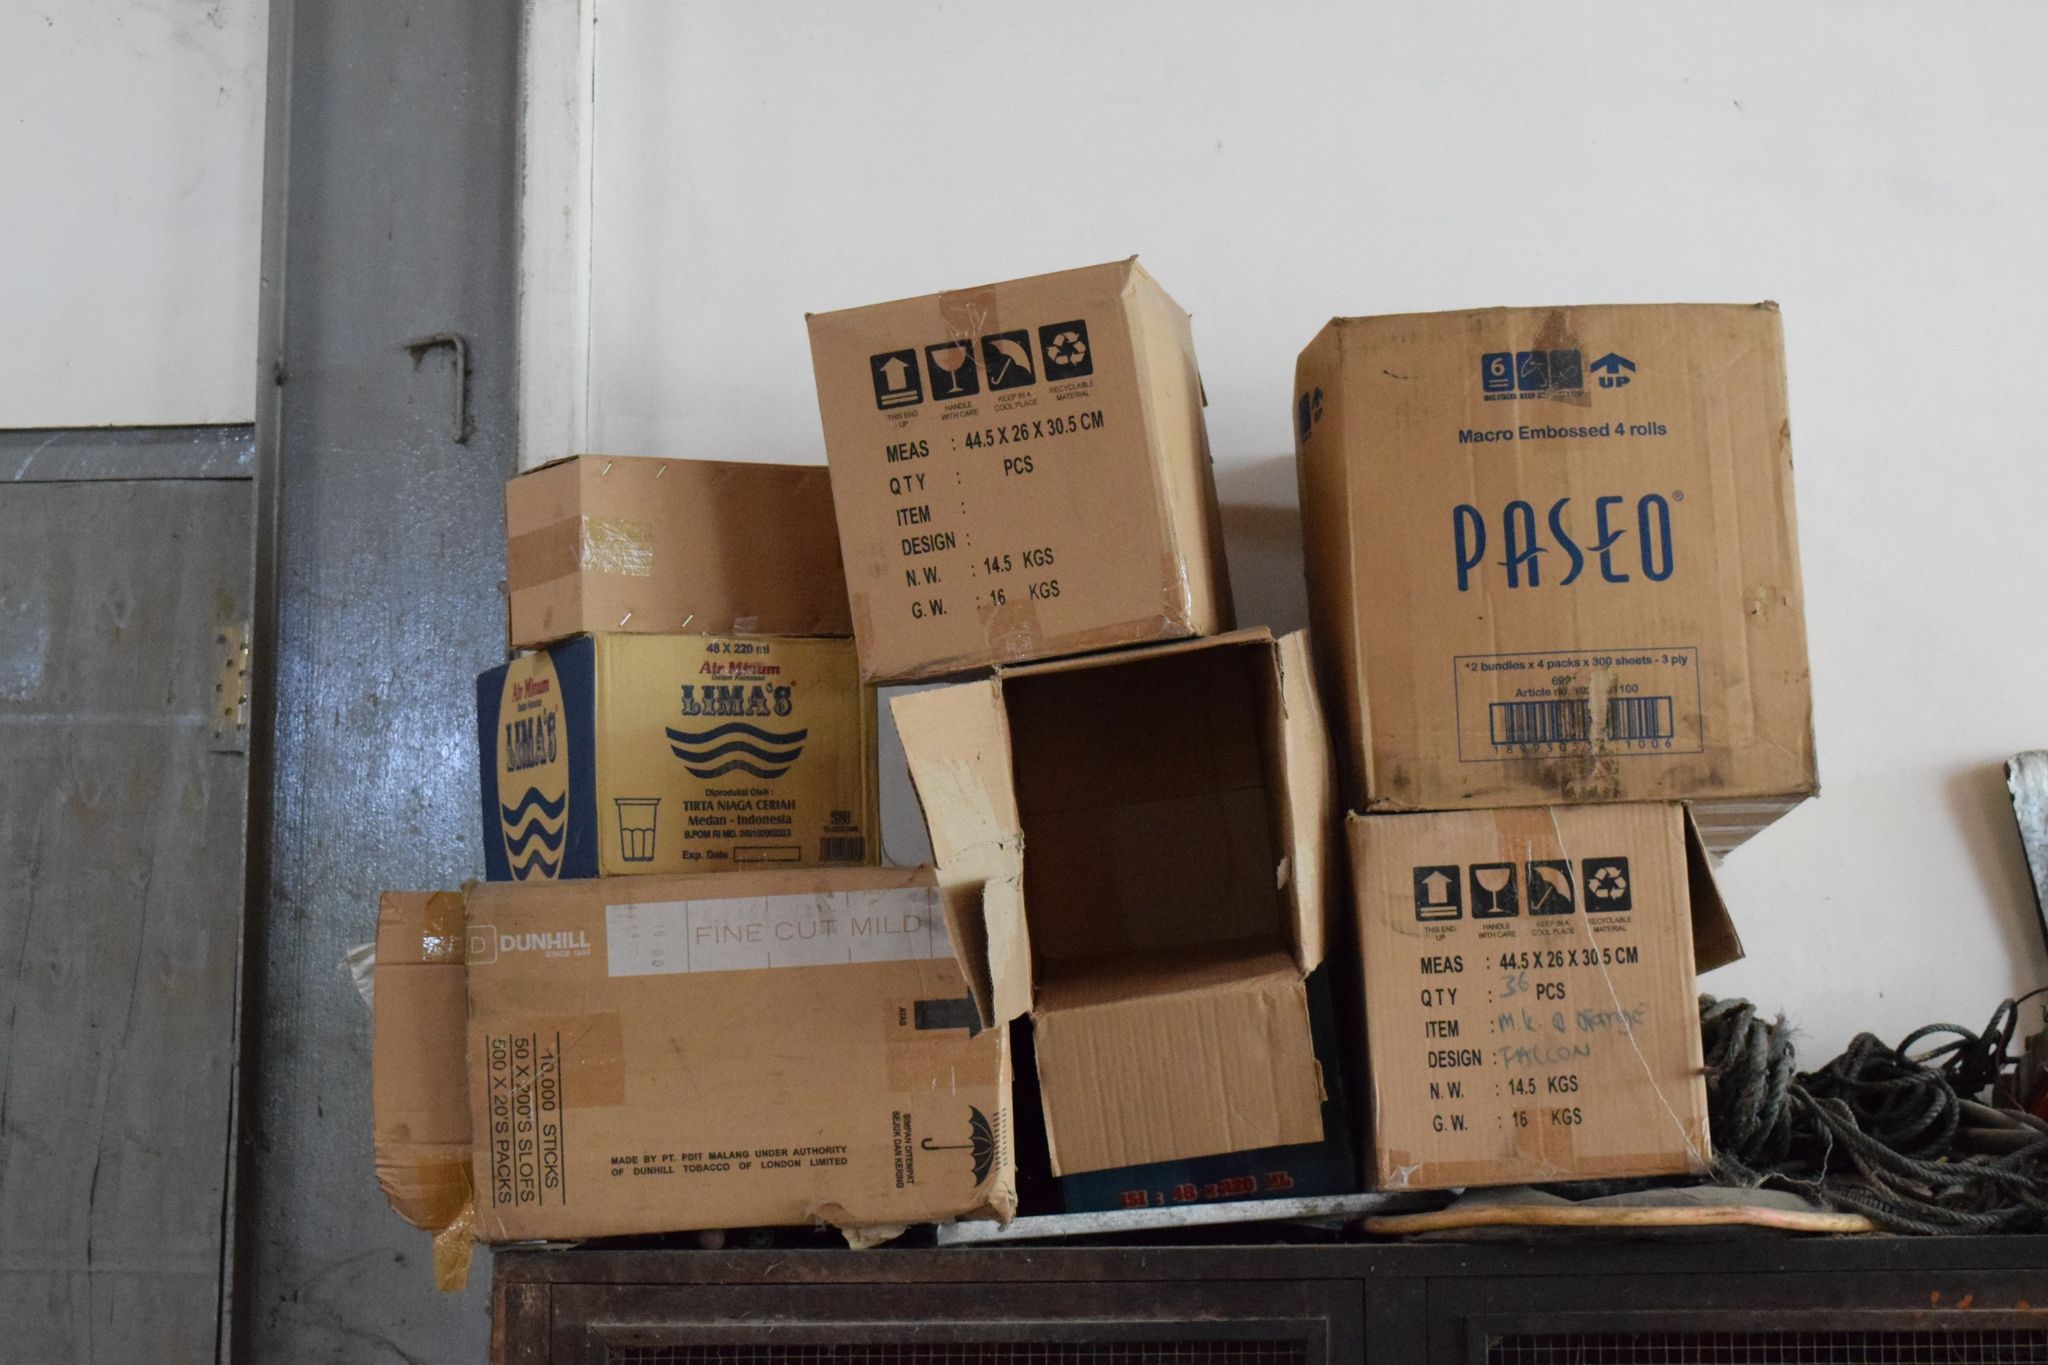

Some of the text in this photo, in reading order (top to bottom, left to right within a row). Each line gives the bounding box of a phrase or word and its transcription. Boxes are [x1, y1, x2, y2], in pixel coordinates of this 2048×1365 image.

[1491, 358, 1504, 375] 6
[1049, 381, 1094, 393] RECYCLABLE
[1599, 377, 1630, 388] UP
[1056, 390, 1089, 402] MATERIAL
[887, 410, 918, 421] THIS END
[941, 408, 979, 421] WITH CARE
[945, 401, 972, 412] HANDLE
[994, 399, 1038, 413] COOL PLACE
[886, 411, 1104, 463] MEAS 44.5 X 26 X 30.5 CM
[1459, 422, 1667, 444] Macro Embossed 4 rolls
[1004, 456, 1033, 476] PCS
[897, 505, 931, 526] ITEM
[902, 532, 956, 556] DESIGN
[1453, 494, 1674, 591] PASEO
[984, 555, 1011, 574] 14.5
[1023, 548, 1054, 568] KGS
[990, 589, 1006, 606] 16
[1029, 580, 1060, 600] KGS
[707, 644, 769, 654] 48 X 220 ml
[699, 661, 724, 674] Air
[1481, 661, 1525, 672] bundles
[1537, 660, 1544, 669] 4
[1547, 658, 1580, 670] packs
[1592, 657, 1612, 667] 300
[1615, 656, 1651, 666] sheets
[1662, 655, 1669, 664] 3
[1671, 654, 1688, 666] ply
[1515, 688, 1551, 698] Article
[683, 800, 796, 811] TIRTA NIAGA CERIAH
[688, 814, 792, 826] Medan Indonesia
[706, 851, 728, 860] Date
[696, 915, 922, 945] FINE CUT MILD
[1553, 927, 1575, 935] PLACE
[470, 930, 590, 953] D DUNHILL
[1421, 956, 1463, 974] MEAS
[1500, 953, 1528, 970] 44.5
[1533, 952, 1544, 968] X
[1548, 951, 1564, 967] 26
[1568, 950, 1578, 966] X
[1615, 947, 1638, 963] CM
[1501, 971, 1529, 997] 36
[1536, 983, 1565, 1000] PCS
[1426, 1020, 1459, 1038] ITEM
[1428, 1049, 1482, 1068] DESIGN
[1508, 1078, 1536, 1095] 14.5
[1548, 1075, 1578, 1094] KGS
[492, 1039, 512, 1204] 500 X 20'S PACKS
[515, 1038, 535, 1203] 50 X 200'S SLOFS
[540, 1049, 558, 1189] 10.000 STICKS
[1513, 1111, 1528, 1128] 16
[1552, 1108, 1582, 1126] KGS
[903, 1113, 911, 1143] SIMPAN
[611, 1145, 847, 1165] MADE BY PT. PDIT MALANG UNDER AUTHORITY
[894, 1139, 902, 1156] DAN
[611, 1157, 847, 1176] OF DUNHILL TOBACCO OF LONDON LIMITED
